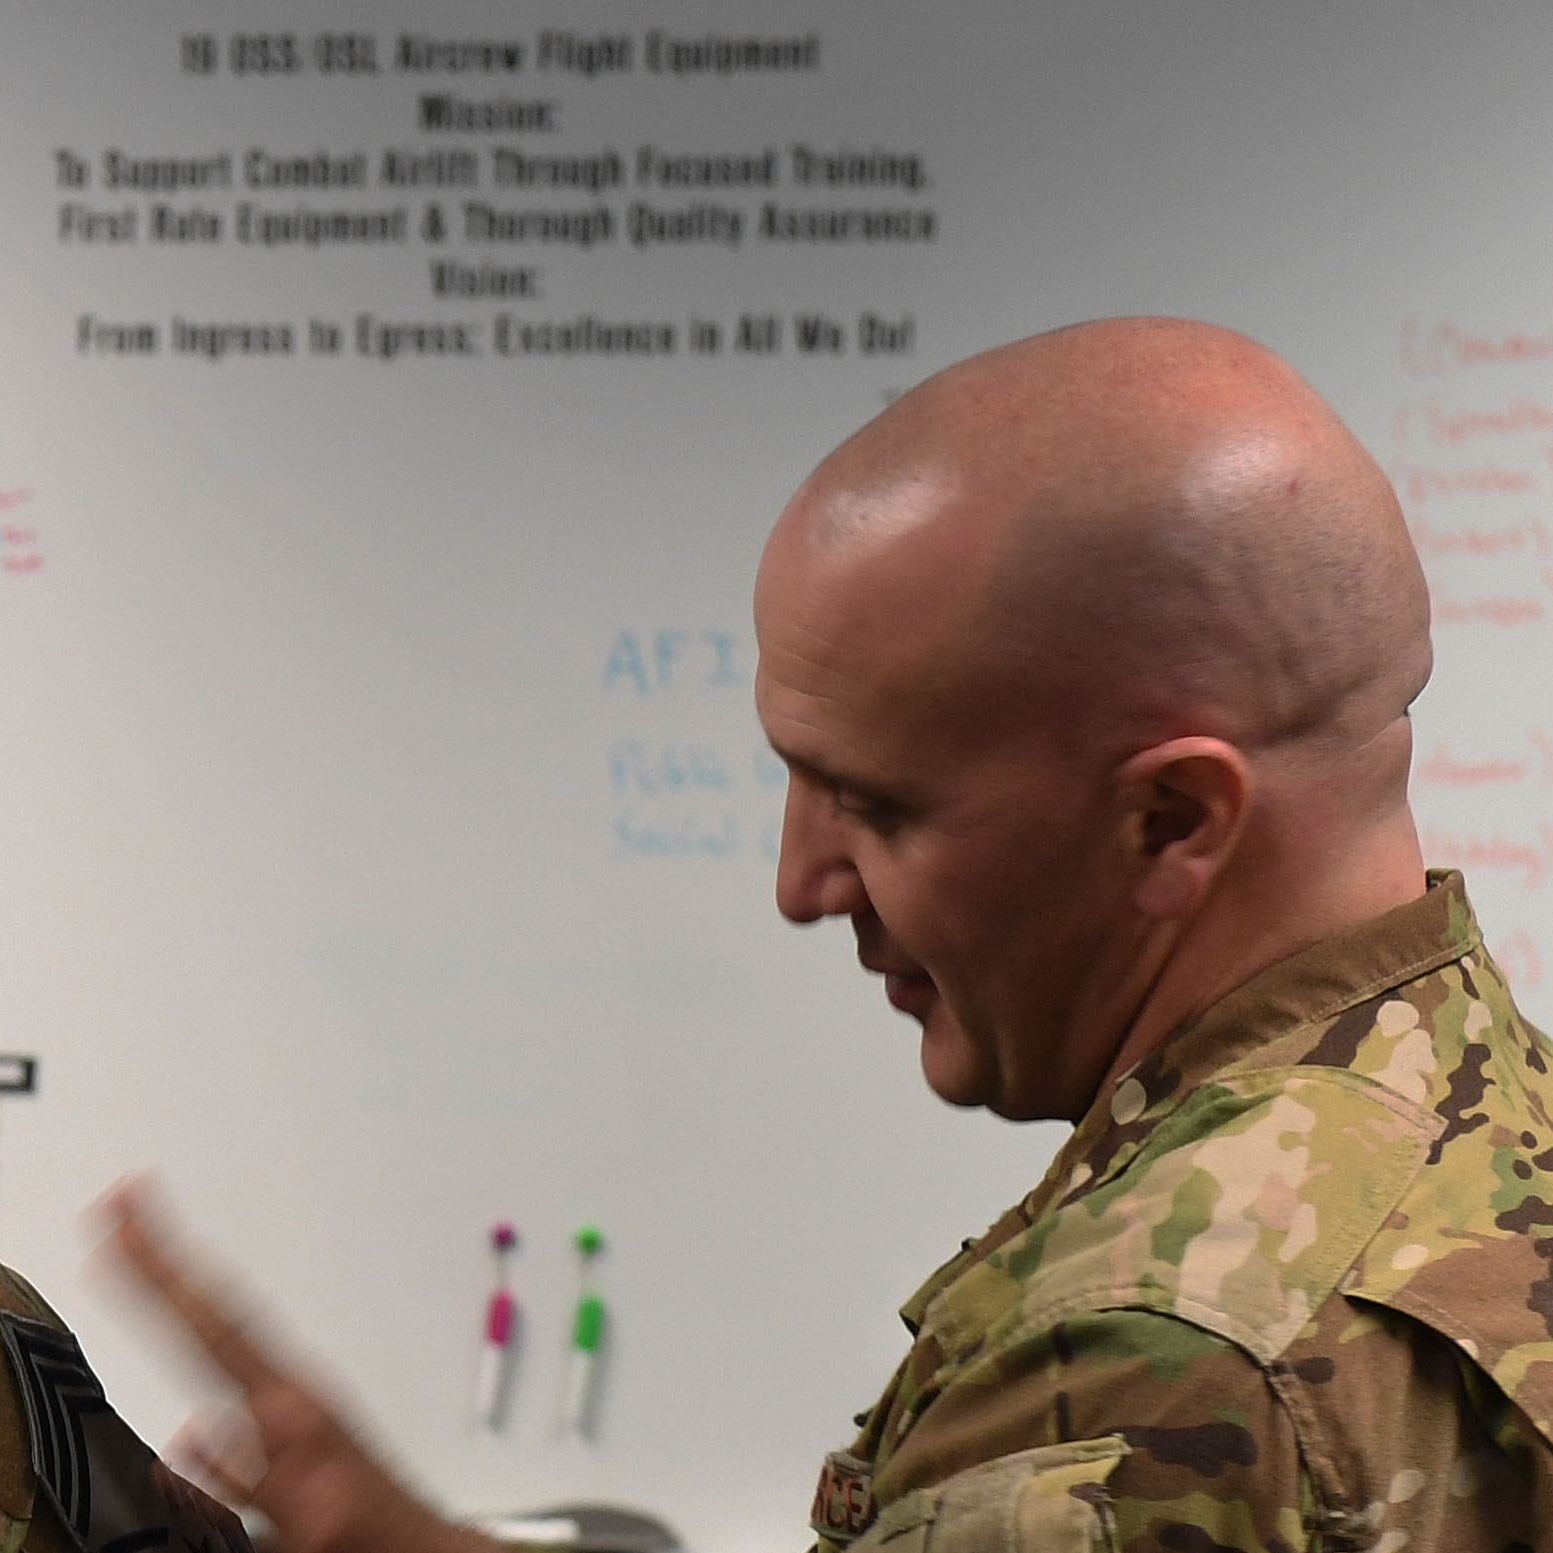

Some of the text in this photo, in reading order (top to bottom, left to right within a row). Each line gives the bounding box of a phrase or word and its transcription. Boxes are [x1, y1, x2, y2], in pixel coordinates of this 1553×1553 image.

[393, 32, 527, 75] Aircrew
[536, 29, 634, 80] Flight
[644, 29, 821, 78] Equipment
[53, 147, 91, 191] To
[102, 147, 232, 195] Support
[243, 147, 368, 191] Combat
[379, 147, 479, 189] Airlift
[491, 146, 626, 196] Through
[635, 144, 779, 189] Focused
[58, 200, 938, 251] First Rate Equipment & Thorough Quality Assurance
[75, 313, 161, 357] From
[171, 316, 296, 364] Ingress
[308, 317, 344, 357] to
[493, 312, 678, 357] Excellence
[689, 318, 724, 357] in
[734, 313, 782, 356] All
[793, 313, 847, 356] We
